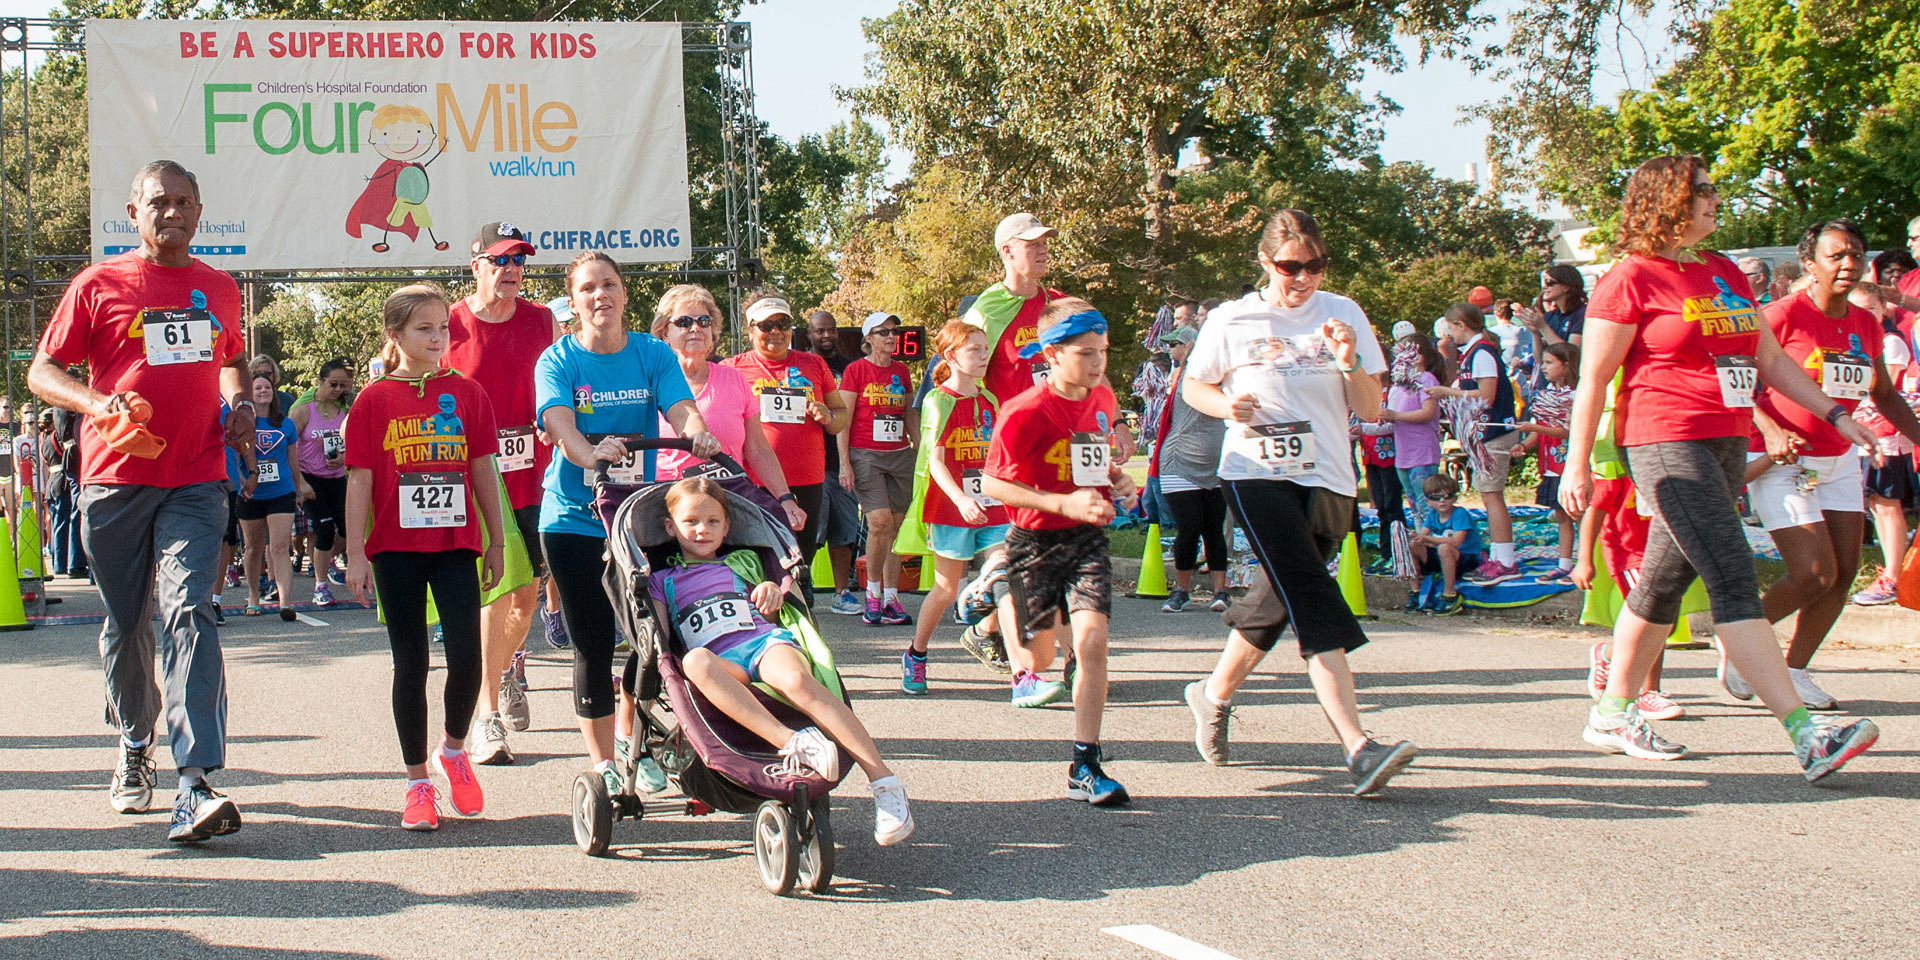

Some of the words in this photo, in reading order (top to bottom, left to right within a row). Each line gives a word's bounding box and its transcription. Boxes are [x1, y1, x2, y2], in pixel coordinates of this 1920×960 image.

[180, 31, 219, 59] BE
[233, 31, 255, 58] A
[268, 31, 444, 59] SUPERHERO
[459, 32, 516, 59] FOR
[530, 32, 597, 60] KIDS
[257, 81, 314, 94] Children's
[316, 81, 362, 96] Hospital
[364, 81, 428, 94] Foundation
[203, 83, 376, 155] Four
[435, 82, 579, 154] Mile
[489, 155, 576, 178] walk/run
[102, 220, 138, 234] Child
[199, 219, 246, 237] Hospital
[164, 322, 191, 346] 61
[1709, 316, 1736, 335] FUN
[1728, 368, 1753, 390] 316
[1833, 365, 1863, 385] 100
[774, 396, 792, 411] 91
[398, 417, 437, 438] MILE
[883, 421, 897, 433] 76
[258, 432, 273, 448] C
[1259, 435, 1303, 460] 159
[402, 443, 433, 464] FUN
[436, 442, 469, 462] RUN
[411, 486, 454, 509] 427
[689, 601, 737, 634] 918
